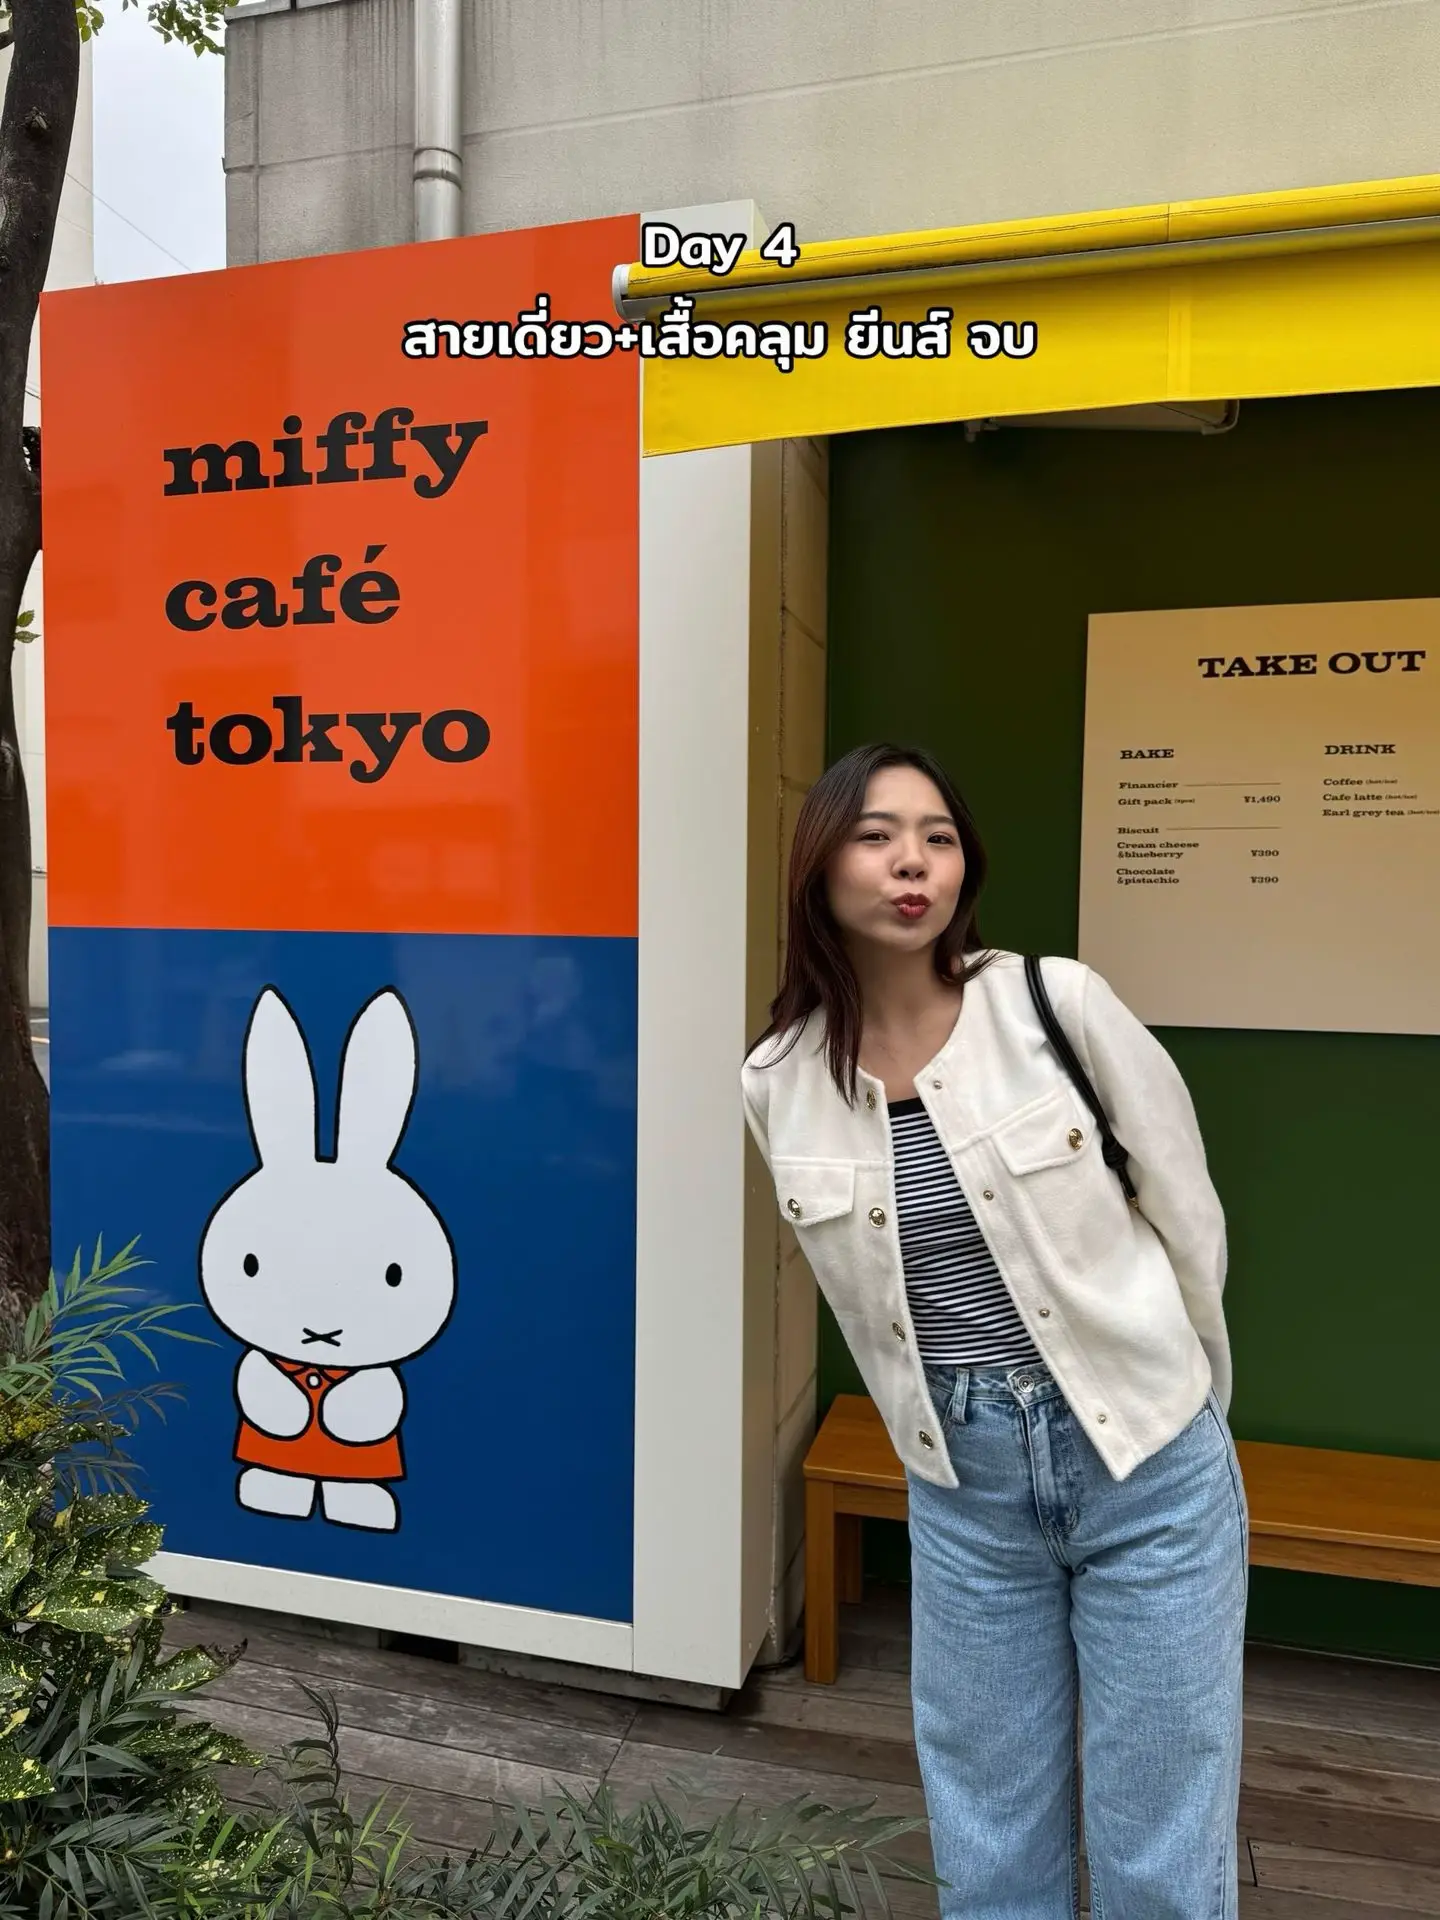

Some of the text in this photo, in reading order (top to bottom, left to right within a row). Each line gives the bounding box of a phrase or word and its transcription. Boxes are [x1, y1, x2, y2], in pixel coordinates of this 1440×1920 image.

[163, 407, 489, 499] miffy
[165, 544, 400, 631] café
[1198, 650, 1426, 678] TAKE OUT
[166, 696, 491, 783] tokyo
[1324, 744, 1396, 755] DRINK
[1120, 749, 1175, 760] BAKE
[1118, 781, 1179, 789] Financier
[1144, 798, 1172, 806] pack
[1244, 796, 1281, 804] ¥1,490
[1117, 851, 1184, 859] &blueberry
[1251, 849, 1279, 857] ¥390
[1117, 877, 1180, 885] &pistachio
[1250, 876, 1279, 884] ¥390
